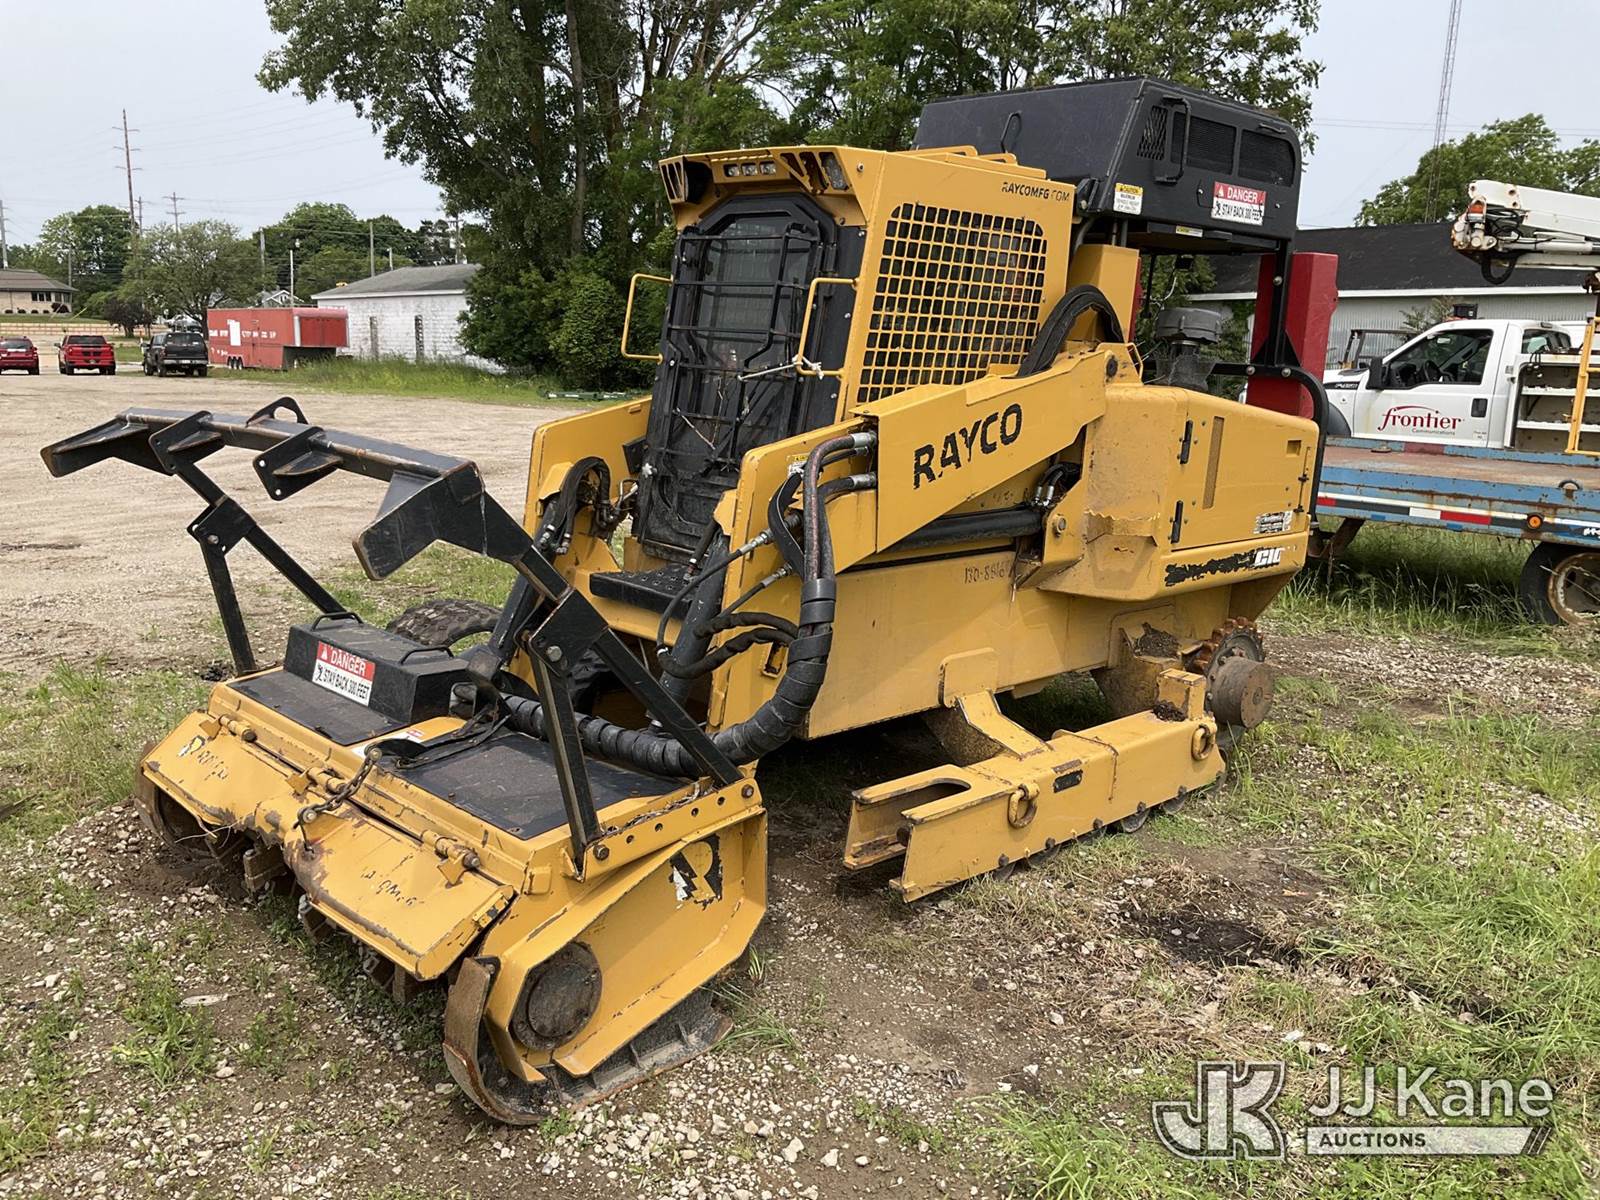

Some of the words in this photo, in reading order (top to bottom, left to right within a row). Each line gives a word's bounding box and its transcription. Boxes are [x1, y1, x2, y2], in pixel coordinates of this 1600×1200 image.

[1227, 186, 1258, 203] DANGER
[1221, 203, 1233, 216] STAY
[1233, 206, 1245, 218] BACK
[1378, 405, 1462, 431] frontier
[913, 403, 1023, 490] RAYCO
[330, 649, 366, 677] DANGER
[323, 668, 336, 685] STAY
[335, 673, 349, 690] BACK
[357, 682, 370, 699] FEET
